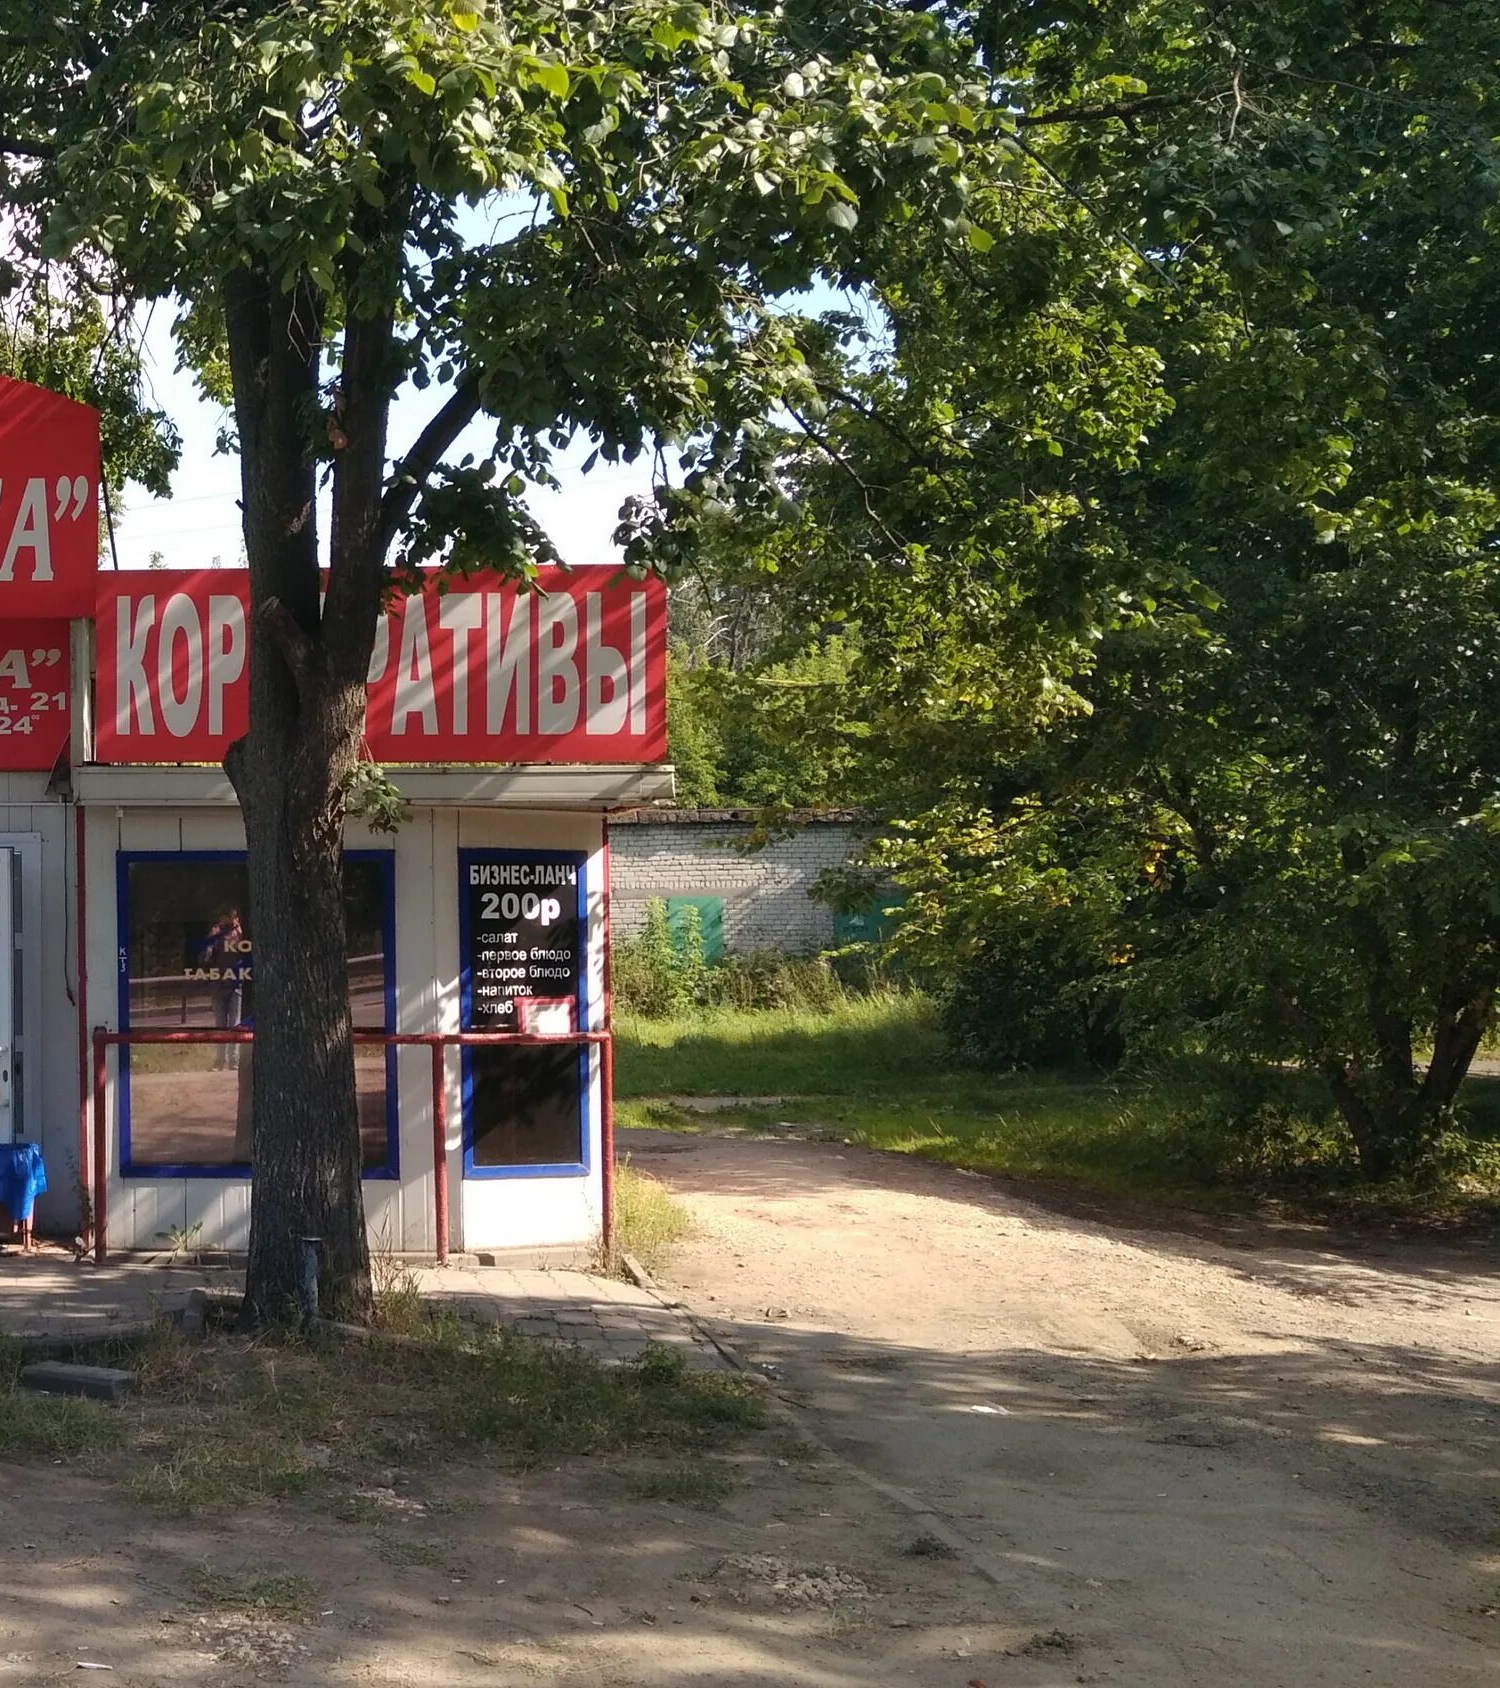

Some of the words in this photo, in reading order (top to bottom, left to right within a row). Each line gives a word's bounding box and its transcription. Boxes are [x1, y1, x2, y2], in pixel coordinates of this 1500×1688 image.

[116, 591, 646, 738] КОРАТИВЫ
[30, 692, 66, 711] 21
[469, 865, 577, 886] БИЗНЕС-ЛАНЧ
[481, 893, 561, 926] 200р
[530, 947, 571, 961] блюдо
[529, 965, 570, 979] блюдо
